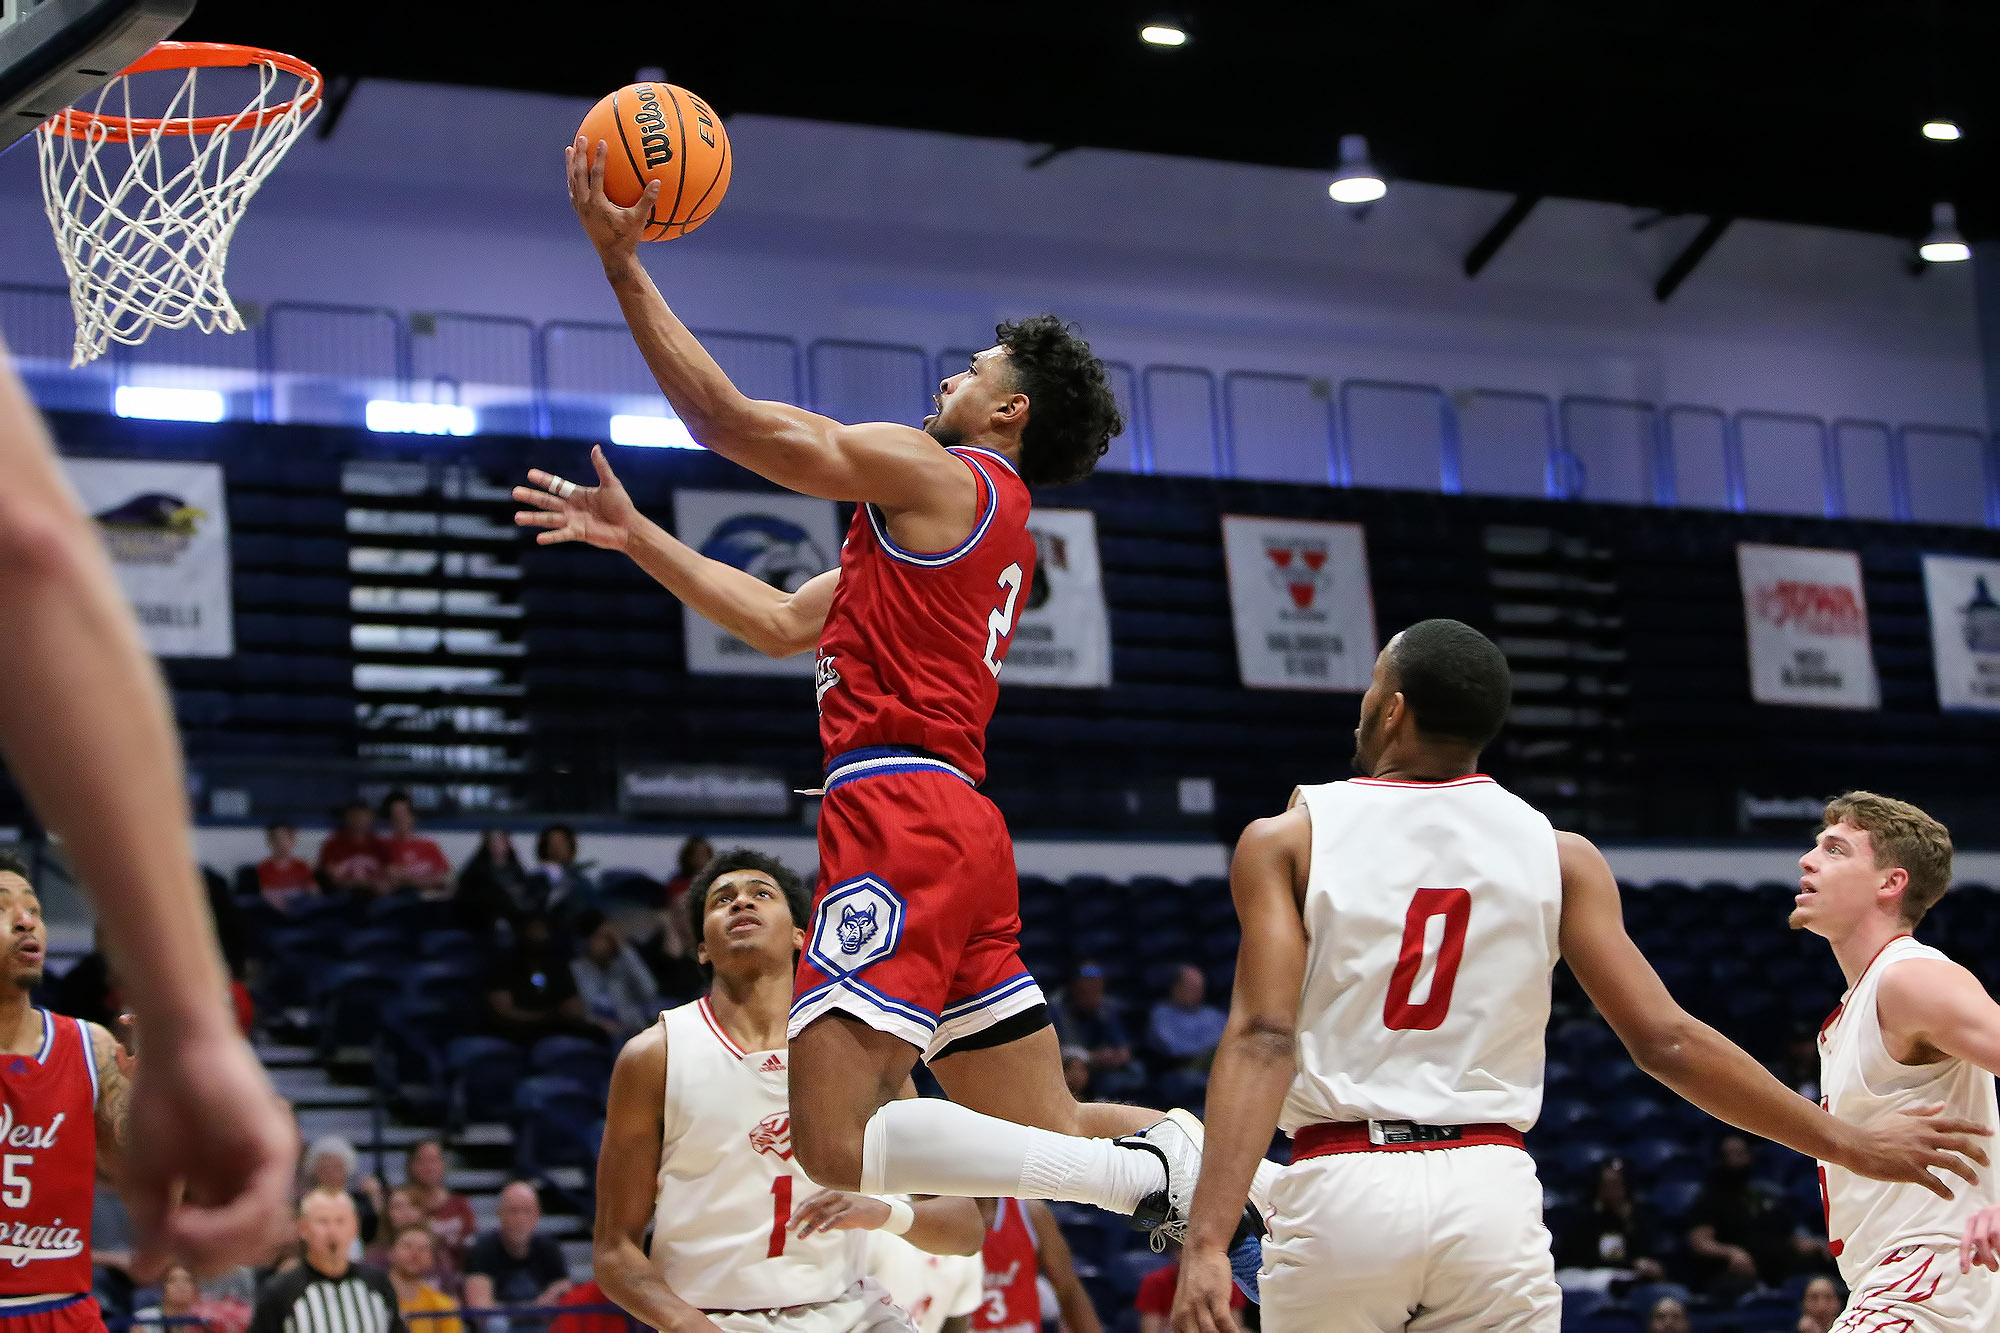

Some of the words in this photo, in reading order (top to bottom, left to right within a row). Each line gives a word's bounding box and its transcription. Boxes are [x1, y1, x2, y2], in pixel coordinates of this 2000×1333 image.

[633, 84, 674, 171] Wilson
[982, 560, 1023, 679] 2
[1383, 887, 1472, 1031] 0
[1, 1153, 34, 1209] 5
[766, 1175, 793, 1258] 1
